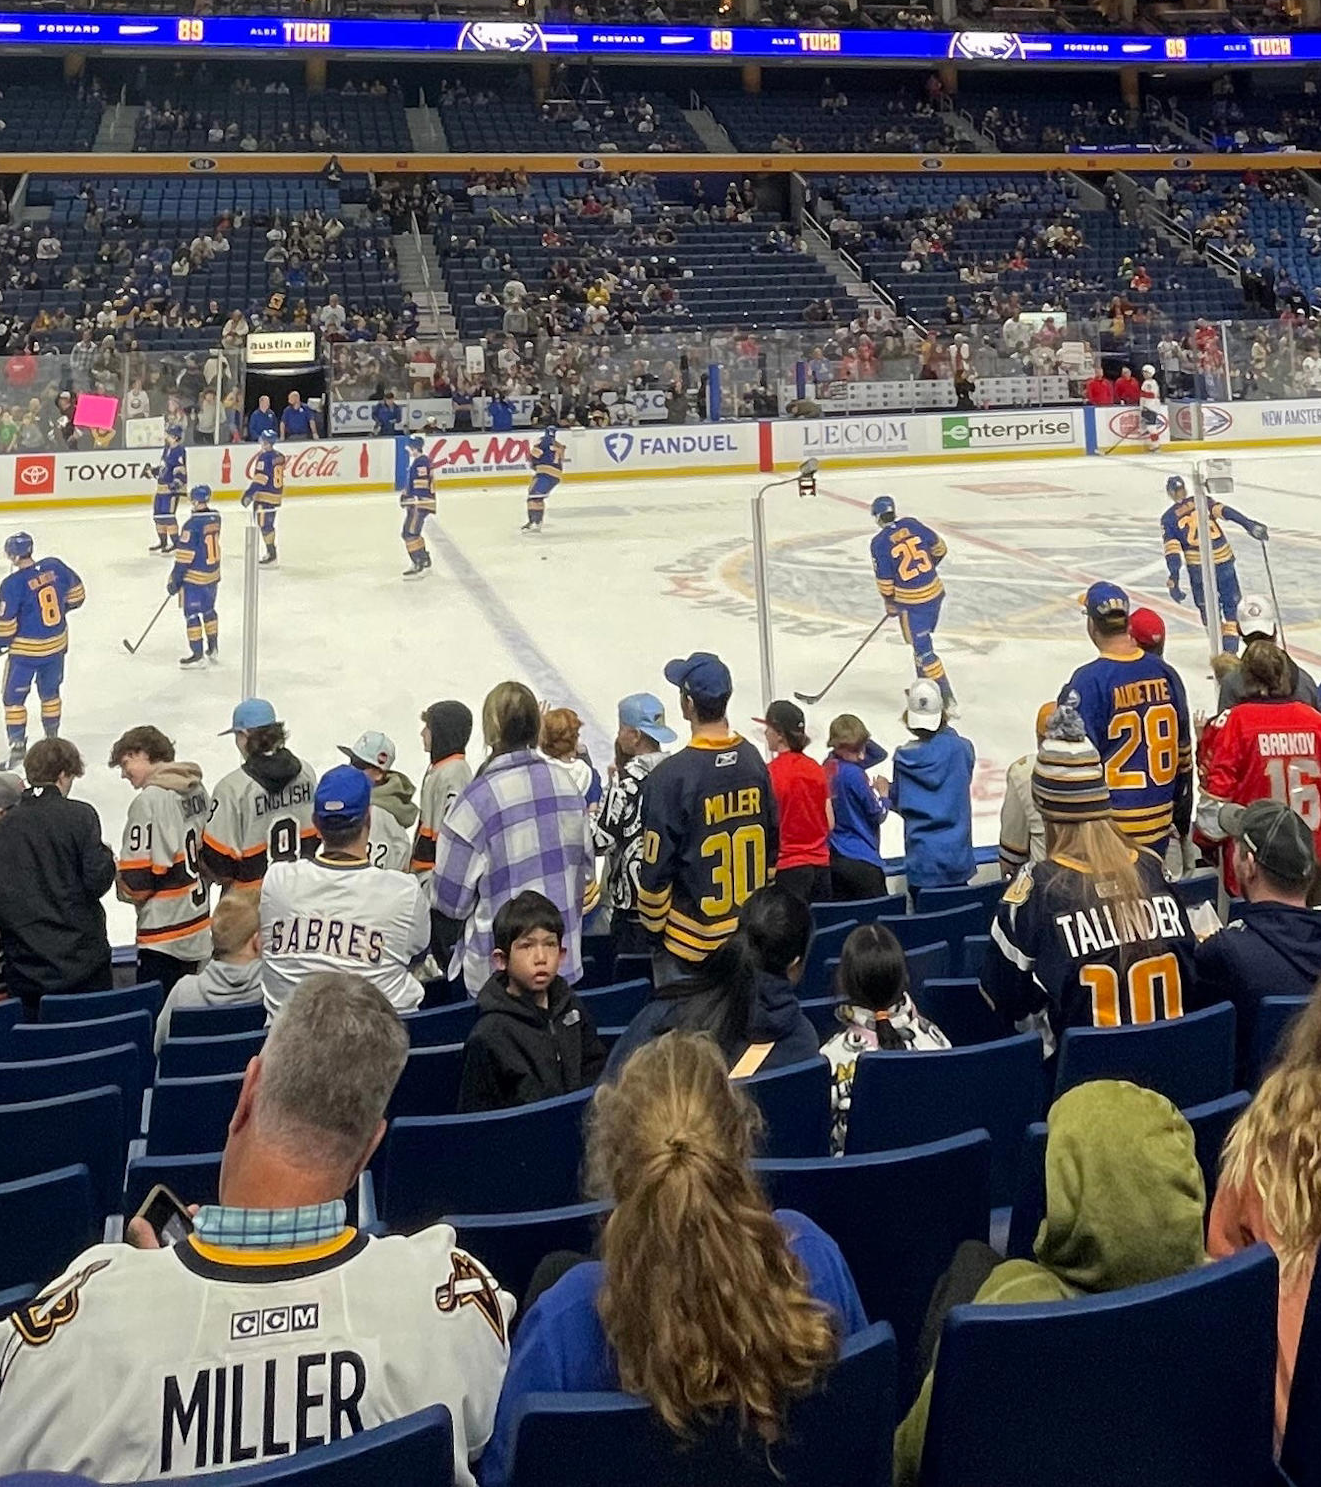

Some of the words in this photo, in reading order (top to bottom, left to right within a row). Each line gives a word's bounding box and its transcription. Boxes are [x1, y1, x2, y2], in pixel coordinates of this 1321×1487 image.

[38, 24, 101, 34] FORWARD
[178, 19, 203, 41] 89
[283, 21, 330, 43] TUCH
[593, 35, 645, 44] FORWARD
[711, 30, 732, 51] 89
[799, 32, 840, 51] TUCH
[1064, 43, 1109, 52] FORWARD
[1165, 38, 1186, 59] 89
[1251, 37, 1291, 57] TUCH
[250, 340, 291, 349] austin
[294, 339, 312, 348] air
[1261, 410, 1284, 426] NEW
[804, 423, 908, 444] LECOM
[948, 419, 1070, 440] enterprise
[428, 439, 479, 470] LA
[640, 435, 737, 455] FANDUEL
[65, 462, 156, 482] TOYOTA
[891, 536, 932, 581] 25
[39, 586, 61, 626] 8
[1113, 678, 1170, 708] AUDETTE
[1106, 704, 1179, 789] 28
[1258, 733, 1315, 756] BARKOV
[256, 783, 311, 817] ENGLISH
[705, 787, 761, 825] MILLER
[1265, 760, 1321, 831] 16
[130, 824, 153, 851] 91
[701, 824, 766, 916] 30
[272, 919, 383, 963] SABRES
[231, 1303, 319, 1340] CCM
[161, 1351, 367, 1472] MILLER
